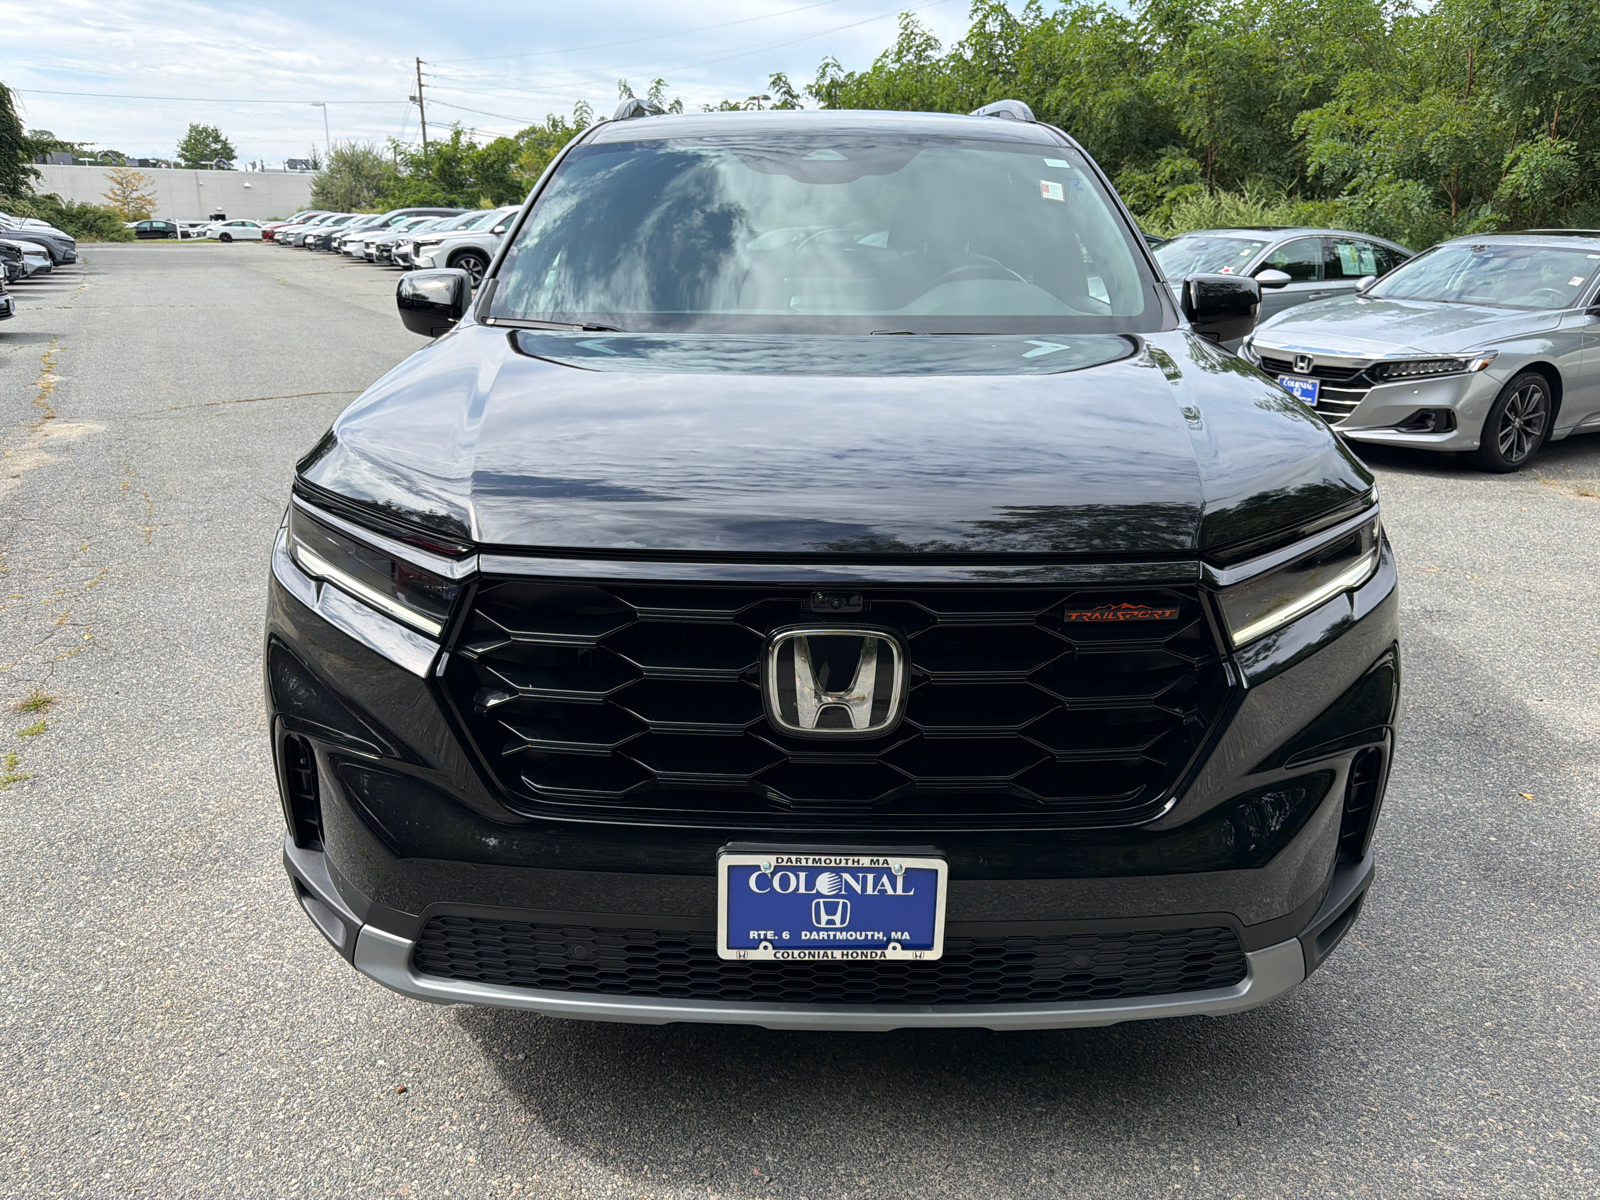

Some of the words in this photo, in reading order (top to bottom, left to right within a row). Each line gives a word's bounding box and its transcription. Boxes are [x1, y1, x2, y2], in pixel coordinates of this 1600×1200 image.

[1067, 609, 1176, 621] TRAILSPORT
[869, 858, 890, 866] MA
[748, 871, 915, 896] COLONIAL
[749, 930, 778, 940] RTE.
[782, 931, 790, 940] 6
[801, 931, 887, 941] DARTMOUTH,
[890, 931, 911, 940] MA
[773, 950, 837, 960] COLONIAL
[840, 950, 887, 960] HONDA
